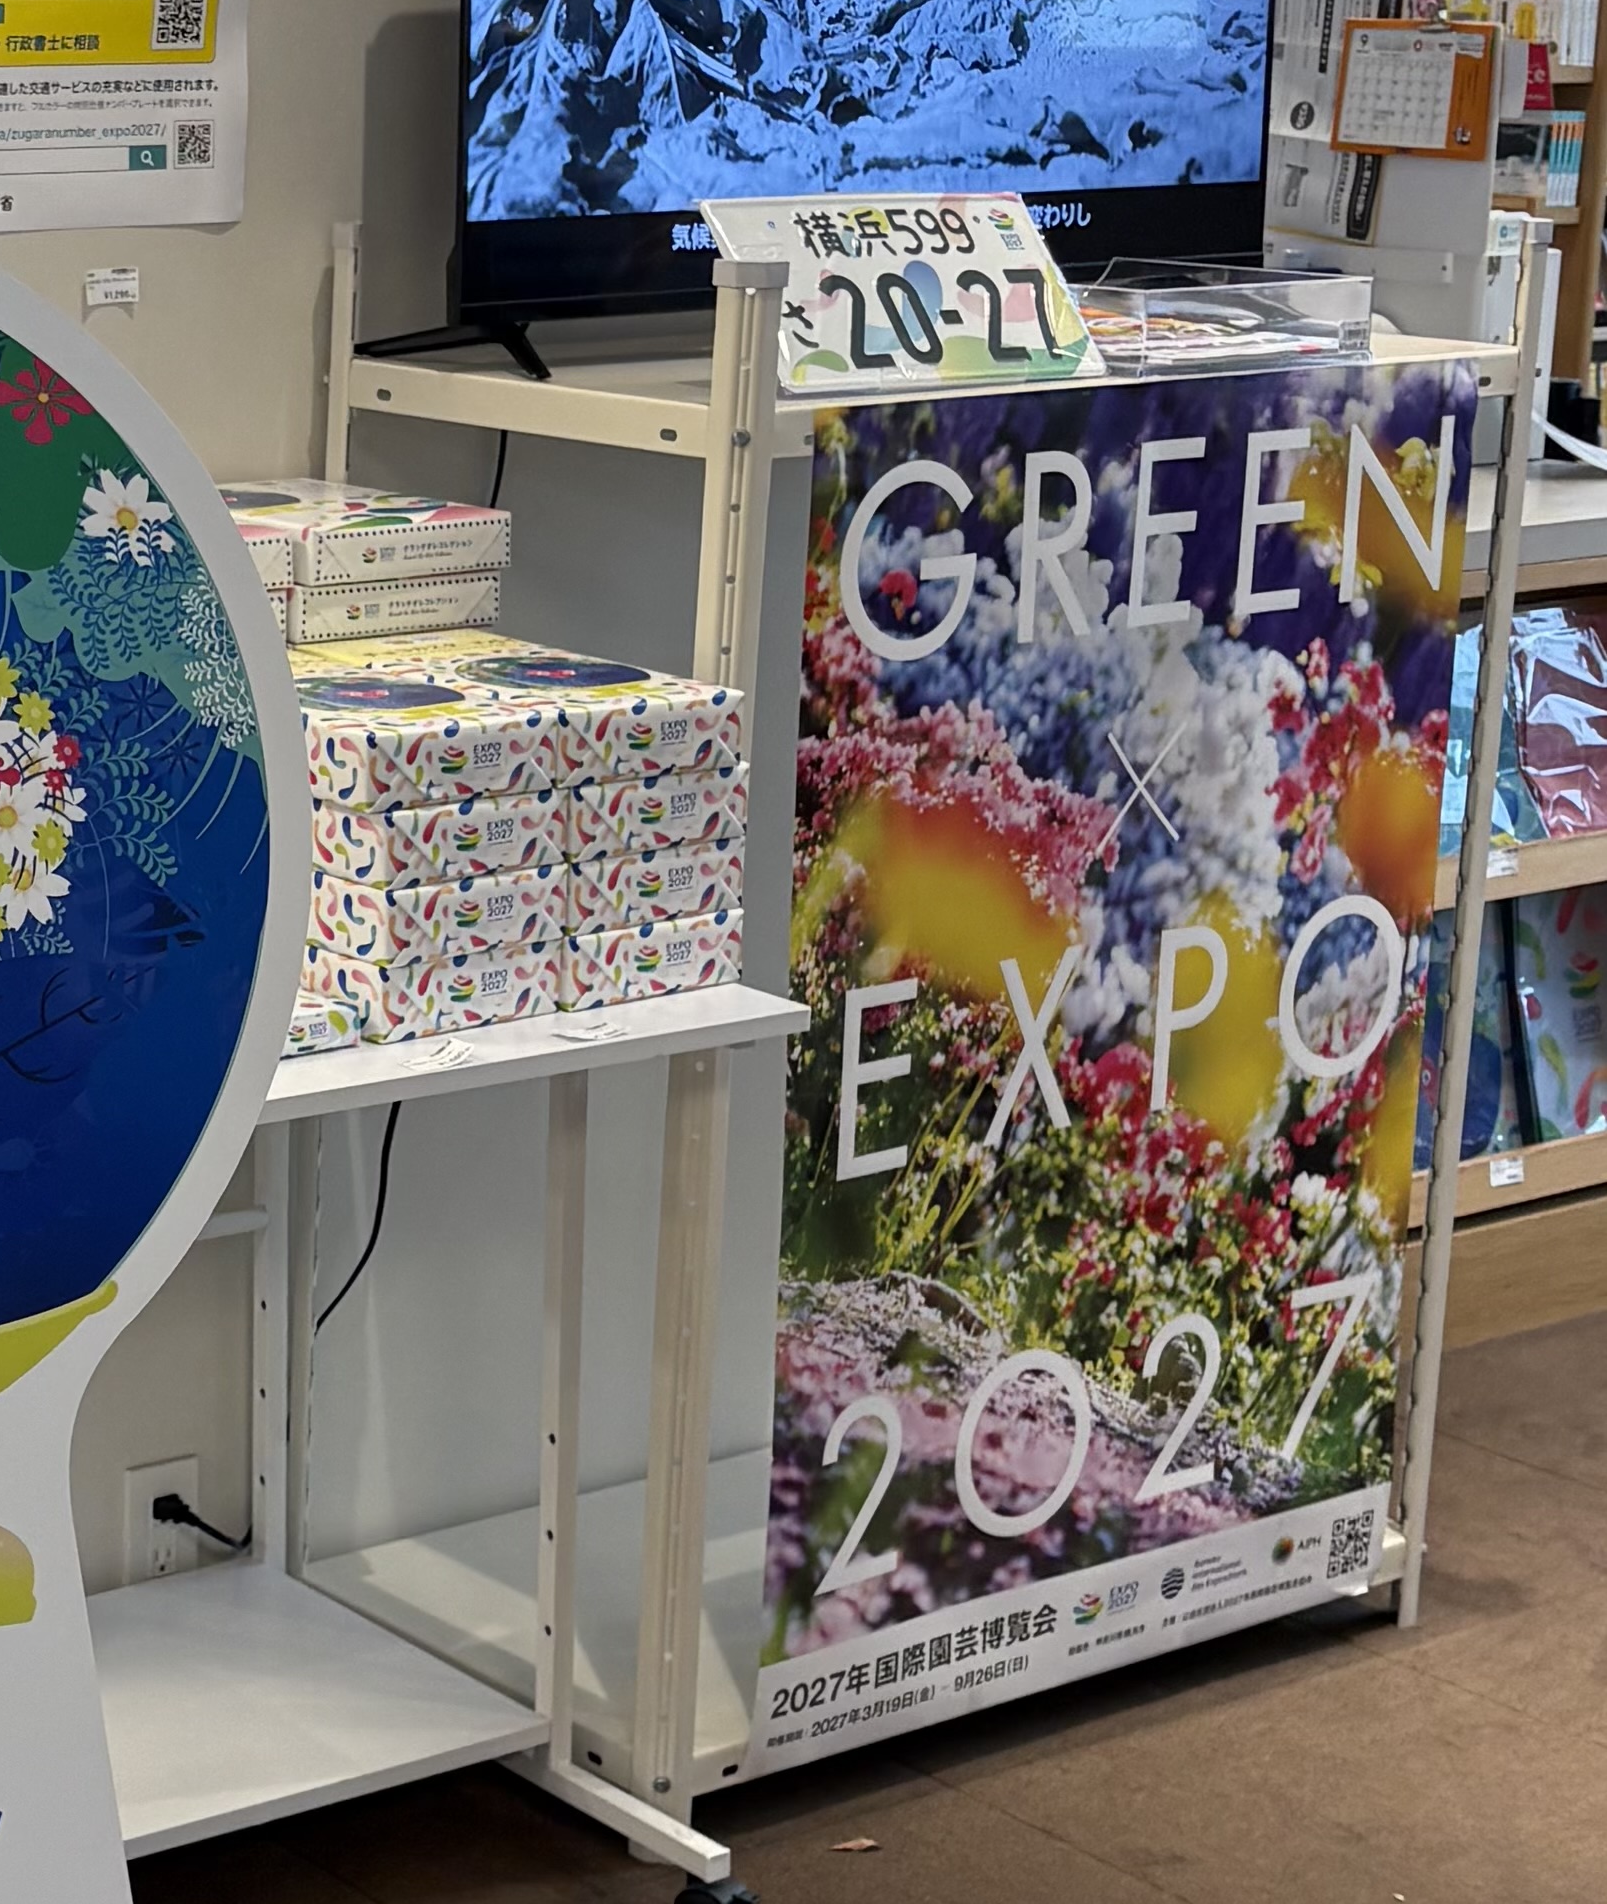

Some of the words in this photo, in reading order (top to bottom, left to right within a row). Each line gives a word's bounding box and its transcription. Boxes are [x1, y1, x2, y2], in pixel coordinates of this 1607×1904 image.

[671, 223, 720, 252] 気候
[782, 300, 819, 349] さ
[818, 267, 1063, 370] 20-27
[840, 413, 1457, 662] GREEN
[835, 894, 1402, 1182] EXPO
[813, 1274, 1374, 1596] 2027
[770, 1603, 1058, 1720] 2027年国際園芸博覧会
